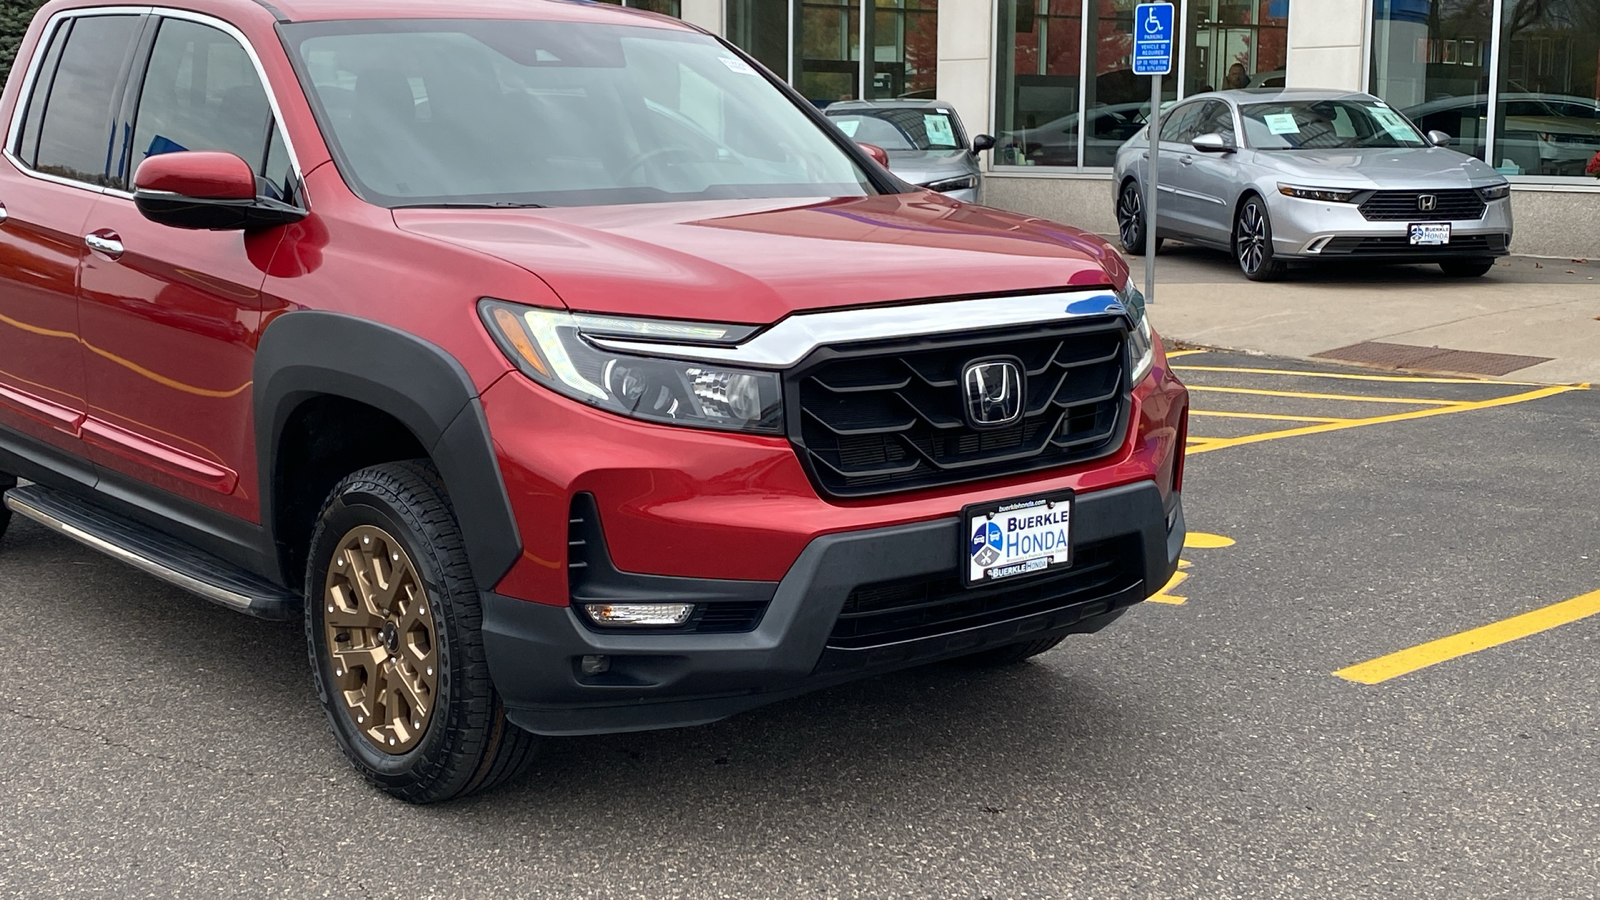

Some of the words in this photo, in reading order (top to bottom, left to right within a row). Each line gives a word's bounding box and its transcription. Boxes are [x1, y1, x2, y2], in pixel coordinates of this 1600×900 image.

[998, 499, 1047, 513] buerklehonda.com
[1007, 510, 1068, 533] BUERKLE
[1006, 529, 1067, 558] HONDA
[992, 563, 1026, 579] BUERKLE
[1026, 559, 1047, 571] HONDA
